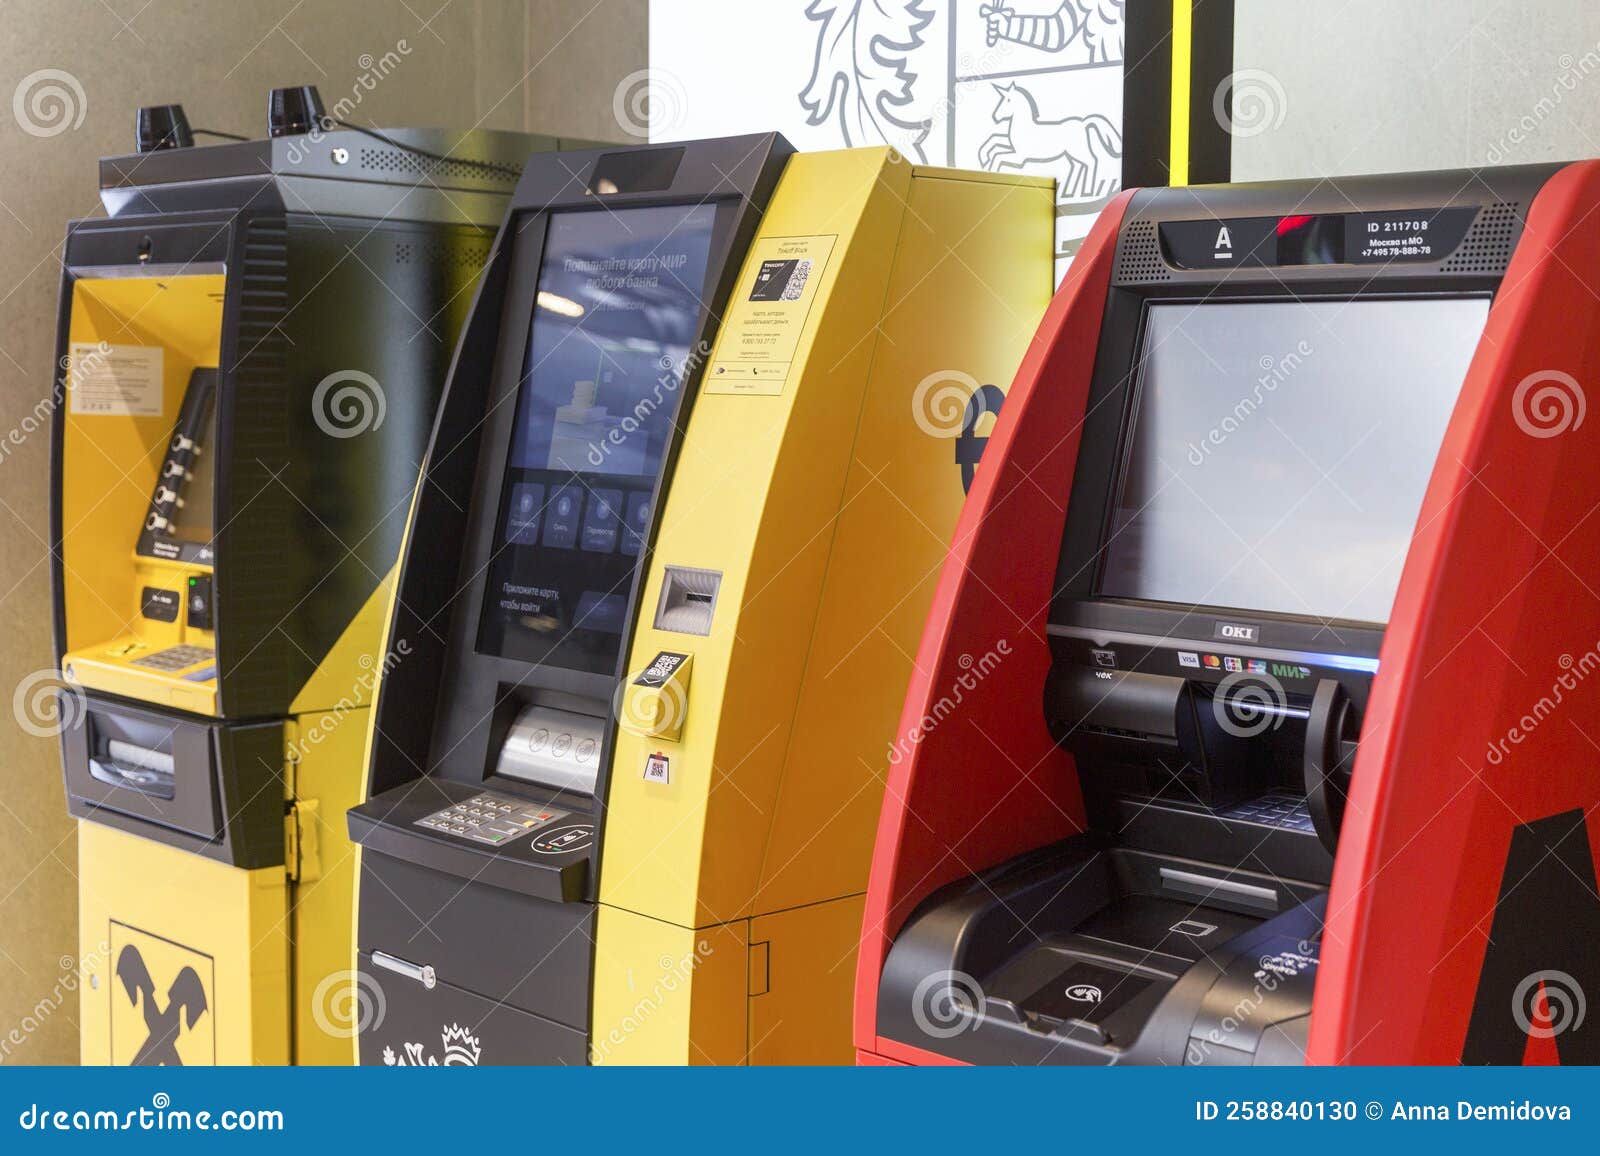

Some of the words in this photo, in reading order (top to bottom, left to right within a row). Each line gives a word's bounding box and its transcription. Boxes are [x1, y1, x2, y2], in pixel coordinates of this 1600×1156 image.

[1367, 222, 1380, 233] ID
[1384, 220, 1429, 232] 211708
[1369, 238, 1401, 247] Москва
[1408, 236, 1424, 245] МО
[1362, 248, 1372, 256] +7
[1373, 248, 1388, 256] 495
[627, 257, 659, 273] карту
[659, 254, 688, 269] МИР
[502, 582, 538, 597] Приложите
[1221, 625, 1254, 639] OKI
[1182, 656, 1197, 664] VISA
[1272, 663, 1311, 679] МИР
